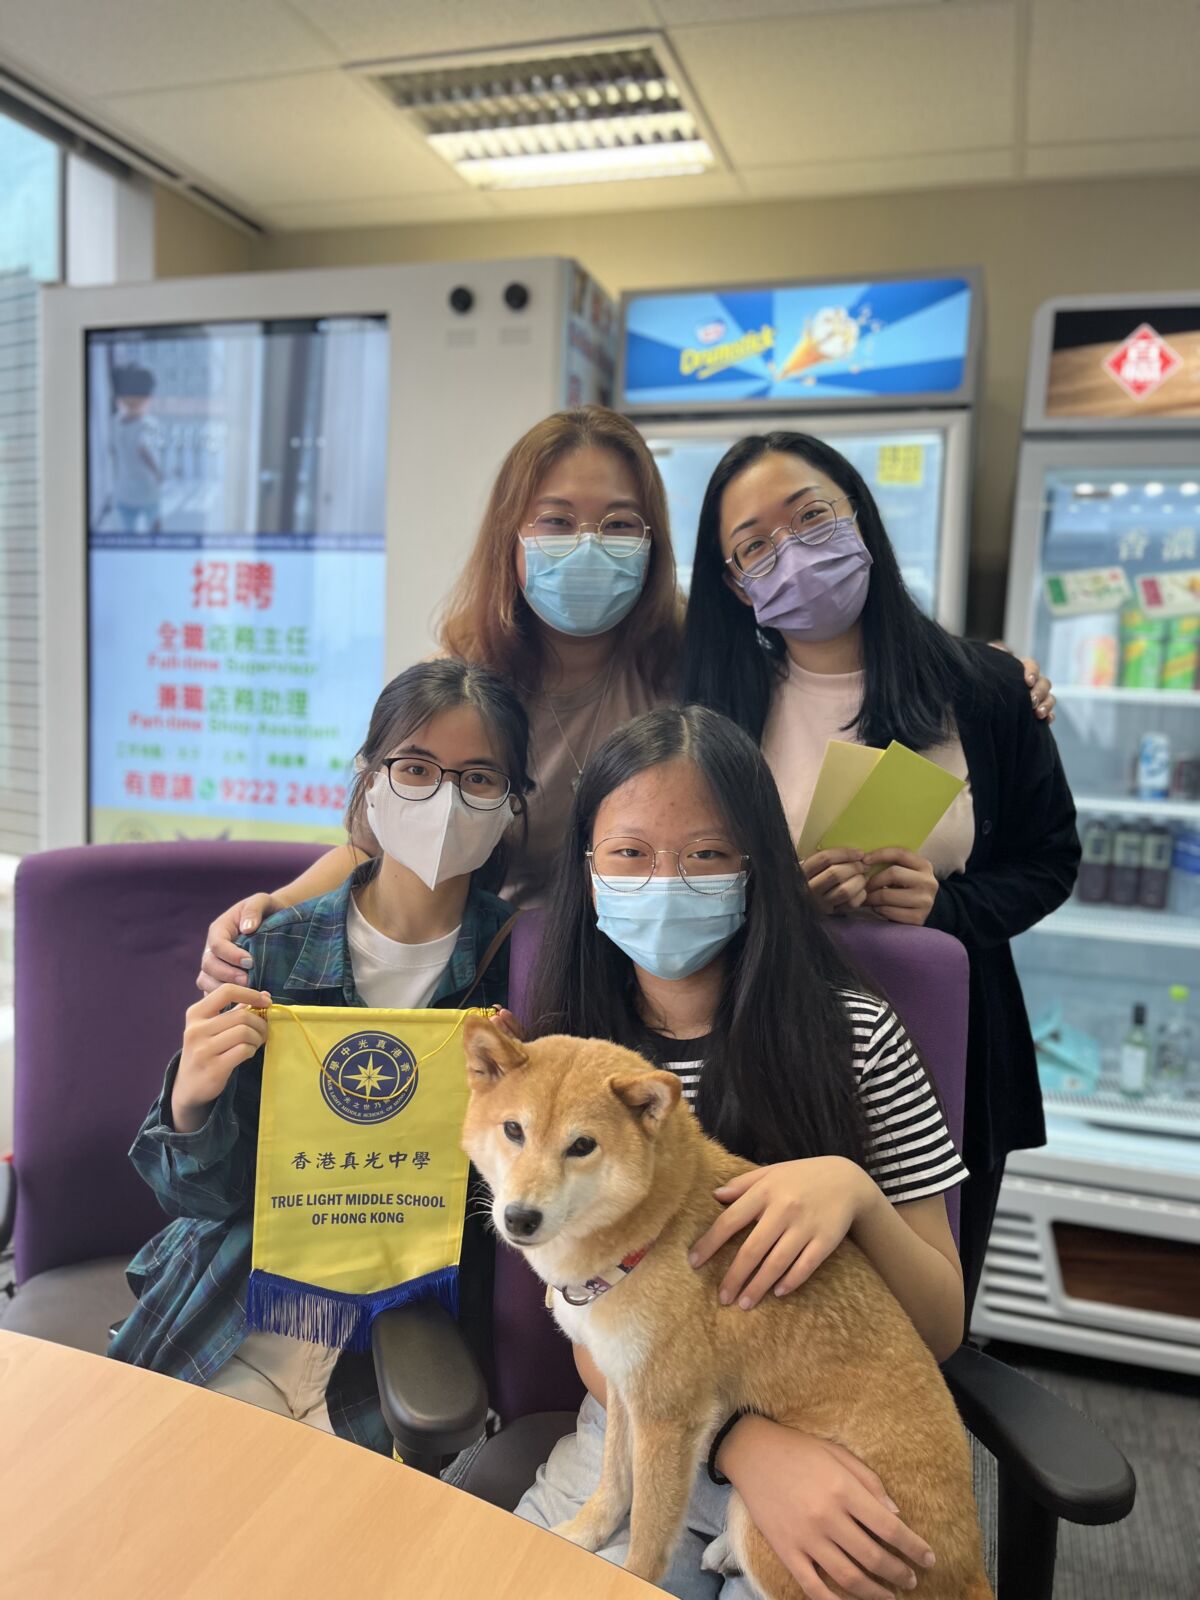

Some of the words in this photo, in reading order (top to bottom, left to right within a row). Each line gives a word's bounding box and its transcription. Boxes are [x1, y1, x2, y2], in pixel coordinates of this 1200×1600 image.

[192, 560, 275, 610] 招聘
[148, 654, 220, 671] Full-time
[129, 711, 203, 731] Part-time
[290, 1151, 432, 1170] 香港真光中學
[271, 1194, 303, 1209] TRUE
[306, 1193, 343, 1206] LIGHT
[345, 1193, 394, 1206] MIDDLE
[396, 1194, 446, 1208] SCHOOL
[311, 1213, 328, 1226] OF
[331, 1212, 367, 1225] HONG
[370, 1212, 405, 1224] KONG
